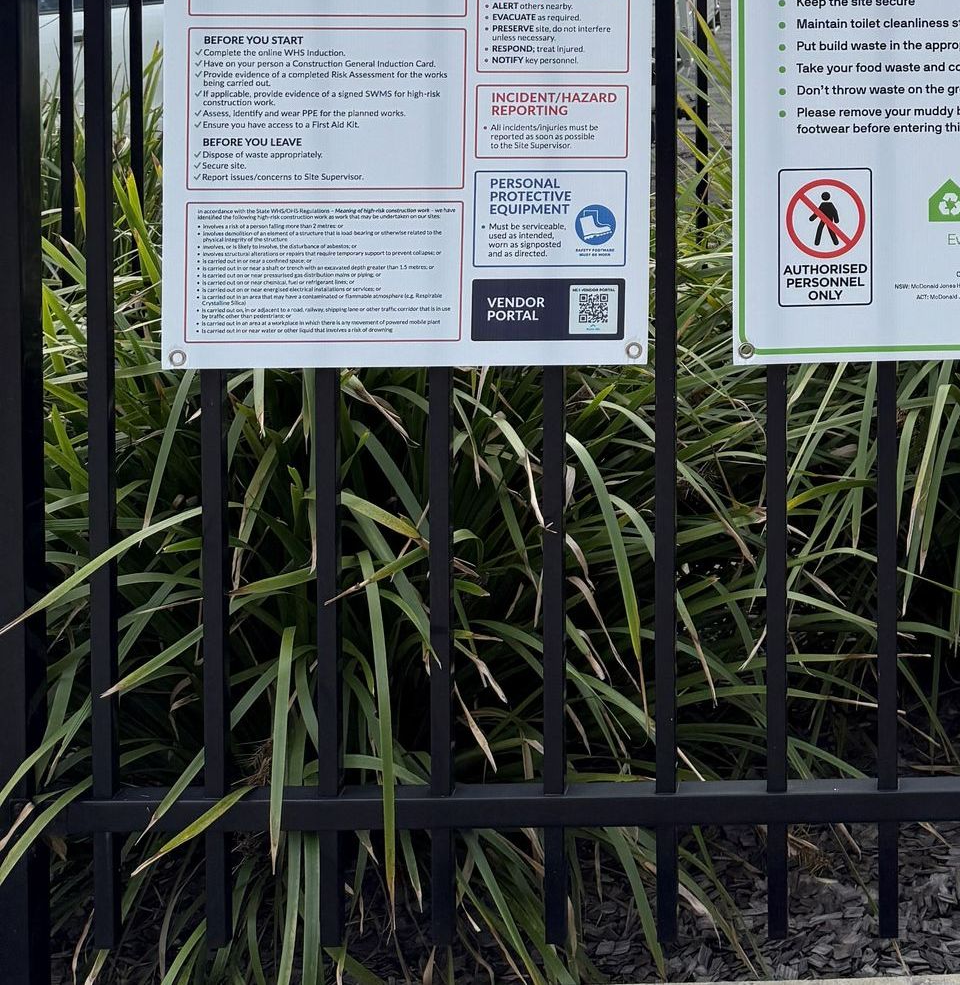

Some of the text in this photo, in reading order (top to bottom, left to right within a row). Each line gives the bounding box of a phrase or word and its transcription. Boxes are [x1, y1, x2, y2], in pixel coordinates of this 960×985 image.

[796, 18, 847, 29] Maintain
[850, 18, 880, 28] toilet
[883, 17, 949, 28] cleanliness
[204, 35, 303, 44] BEFORE YOU START
[492, 92, 617, 103] INCIDENT/HAZARD
[491, 105, 567, 115] REPORTING
[202, 137, 302, 146] BEFORE YOU LEAVE
[490, 178, 560, 188] PERSONAL
[490, 190, 571, 201] PROTECTIVE
[489, 203, 569, 216] EQUIPMENT
[522, 222, 566, 232] serviceable,
[783, 263, 868, 276] AUTHORISED
[786, 276, 865, 288] PERSONNEL
[808, 289, 842, 300] ONLY
[487, 296, 544, 308] VENDOR
[487, 310, 538, 321] PORTAL
